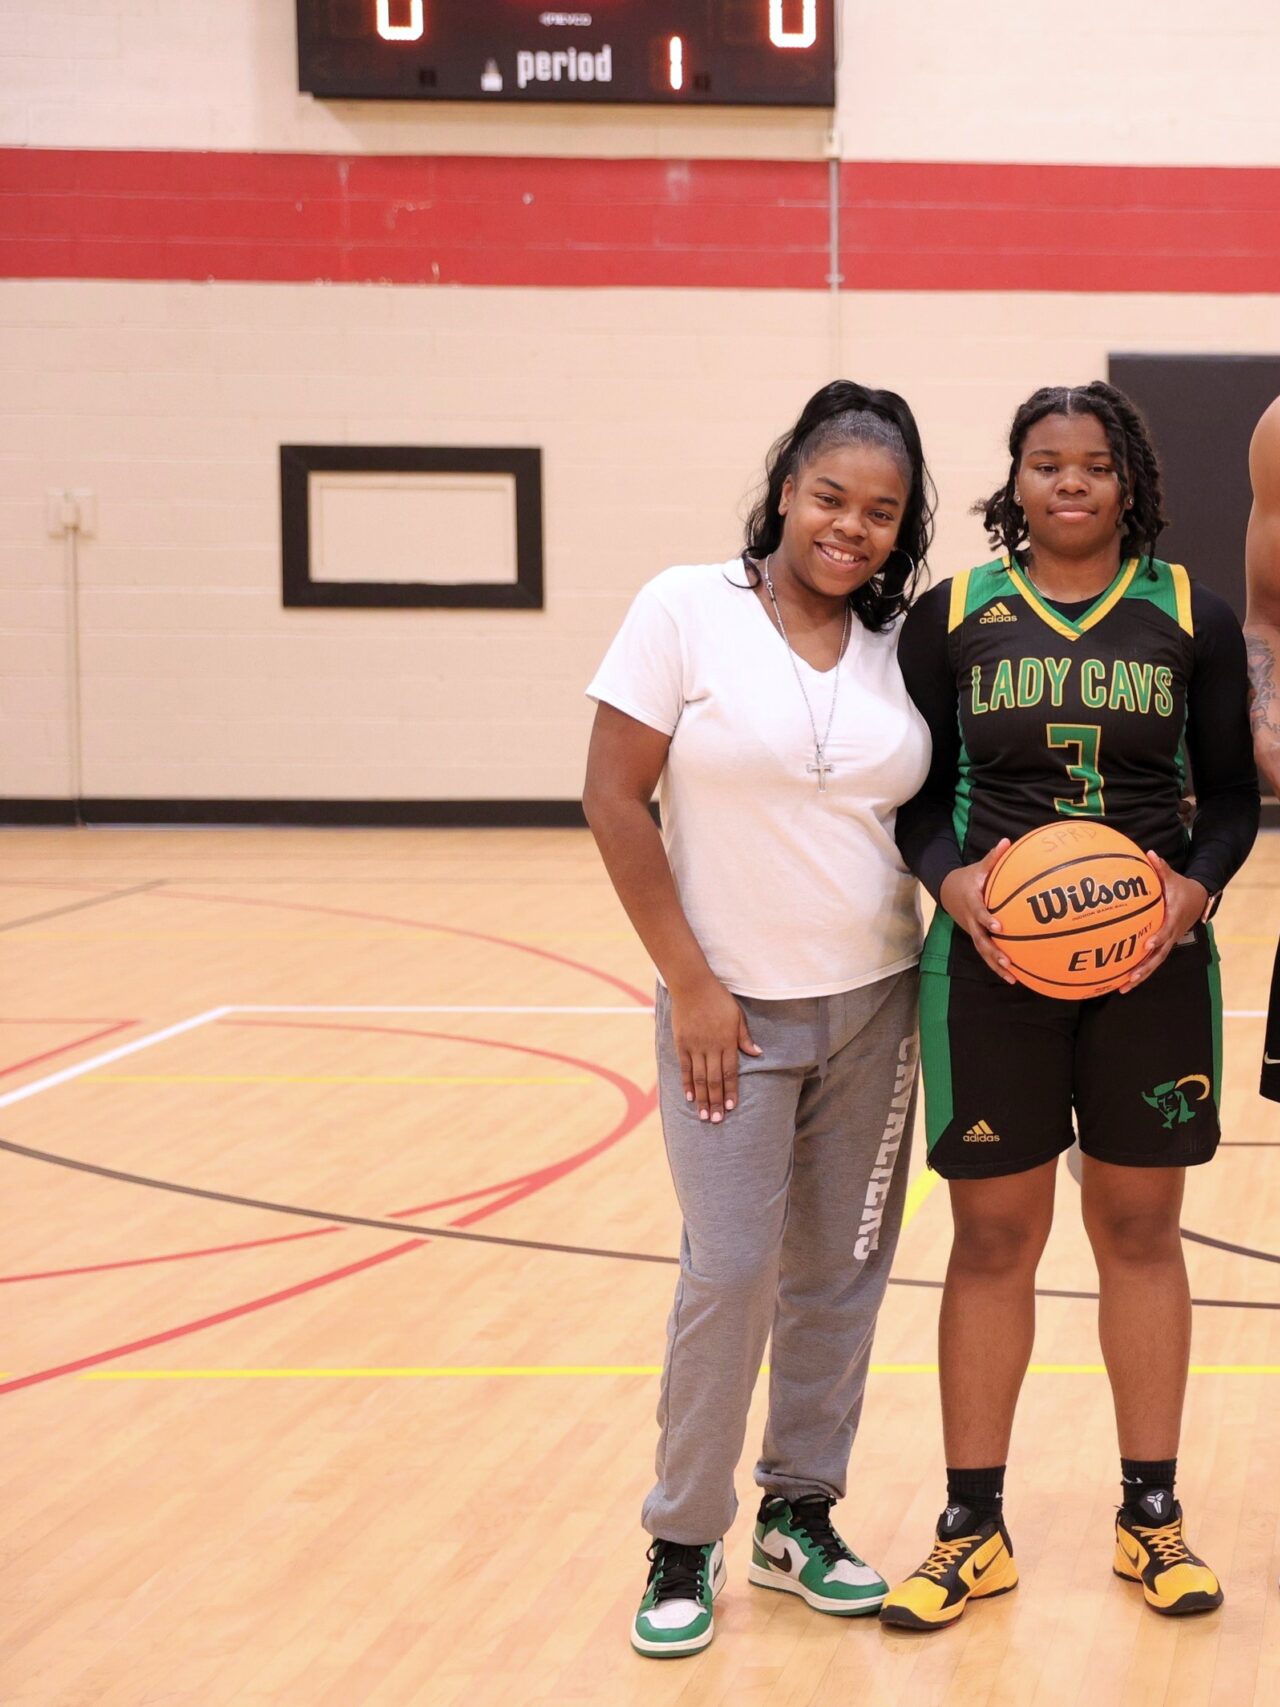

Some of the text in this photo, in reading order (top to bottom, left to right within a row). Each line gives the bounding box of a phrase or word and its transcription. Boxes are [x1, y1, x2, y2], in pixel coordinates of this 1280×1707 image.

[517, 36, 683, 90] period 1
[979, 614, 1017, 624] adidas
[972, 657, 1173, 717] LADY CAVS
[1046, 723, 1105, 817] 3
[1026, 875, 1149, 925] Wilson
[963, 1133, 1000, 1143] adidas
